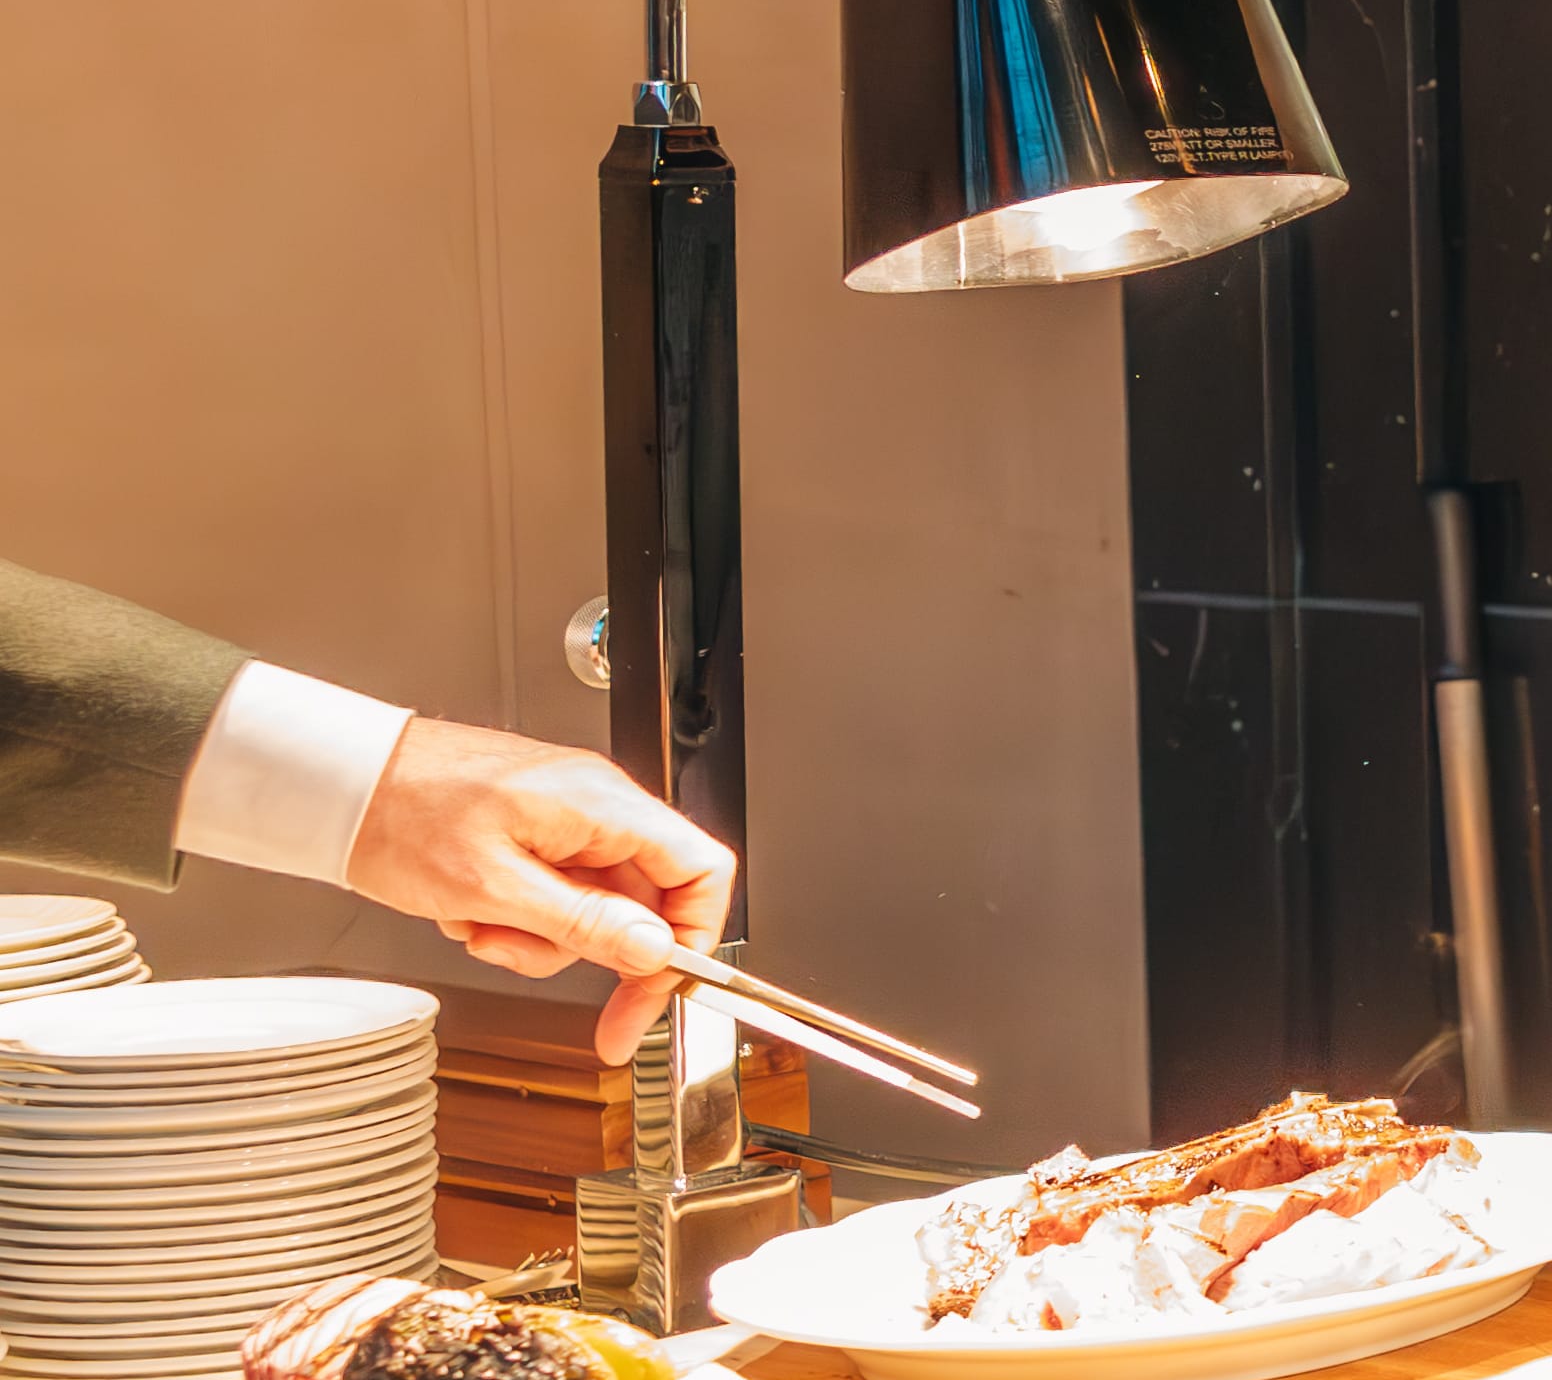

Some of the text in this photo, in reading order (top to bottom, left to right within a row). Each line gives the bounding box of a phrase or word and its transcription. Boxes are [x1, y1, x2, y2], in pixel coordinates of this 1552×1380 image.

[1233, 126, 1249, 136] OF
[1204, 139, 1224, 149] OR
[1238, 151, 1248, 160] R
